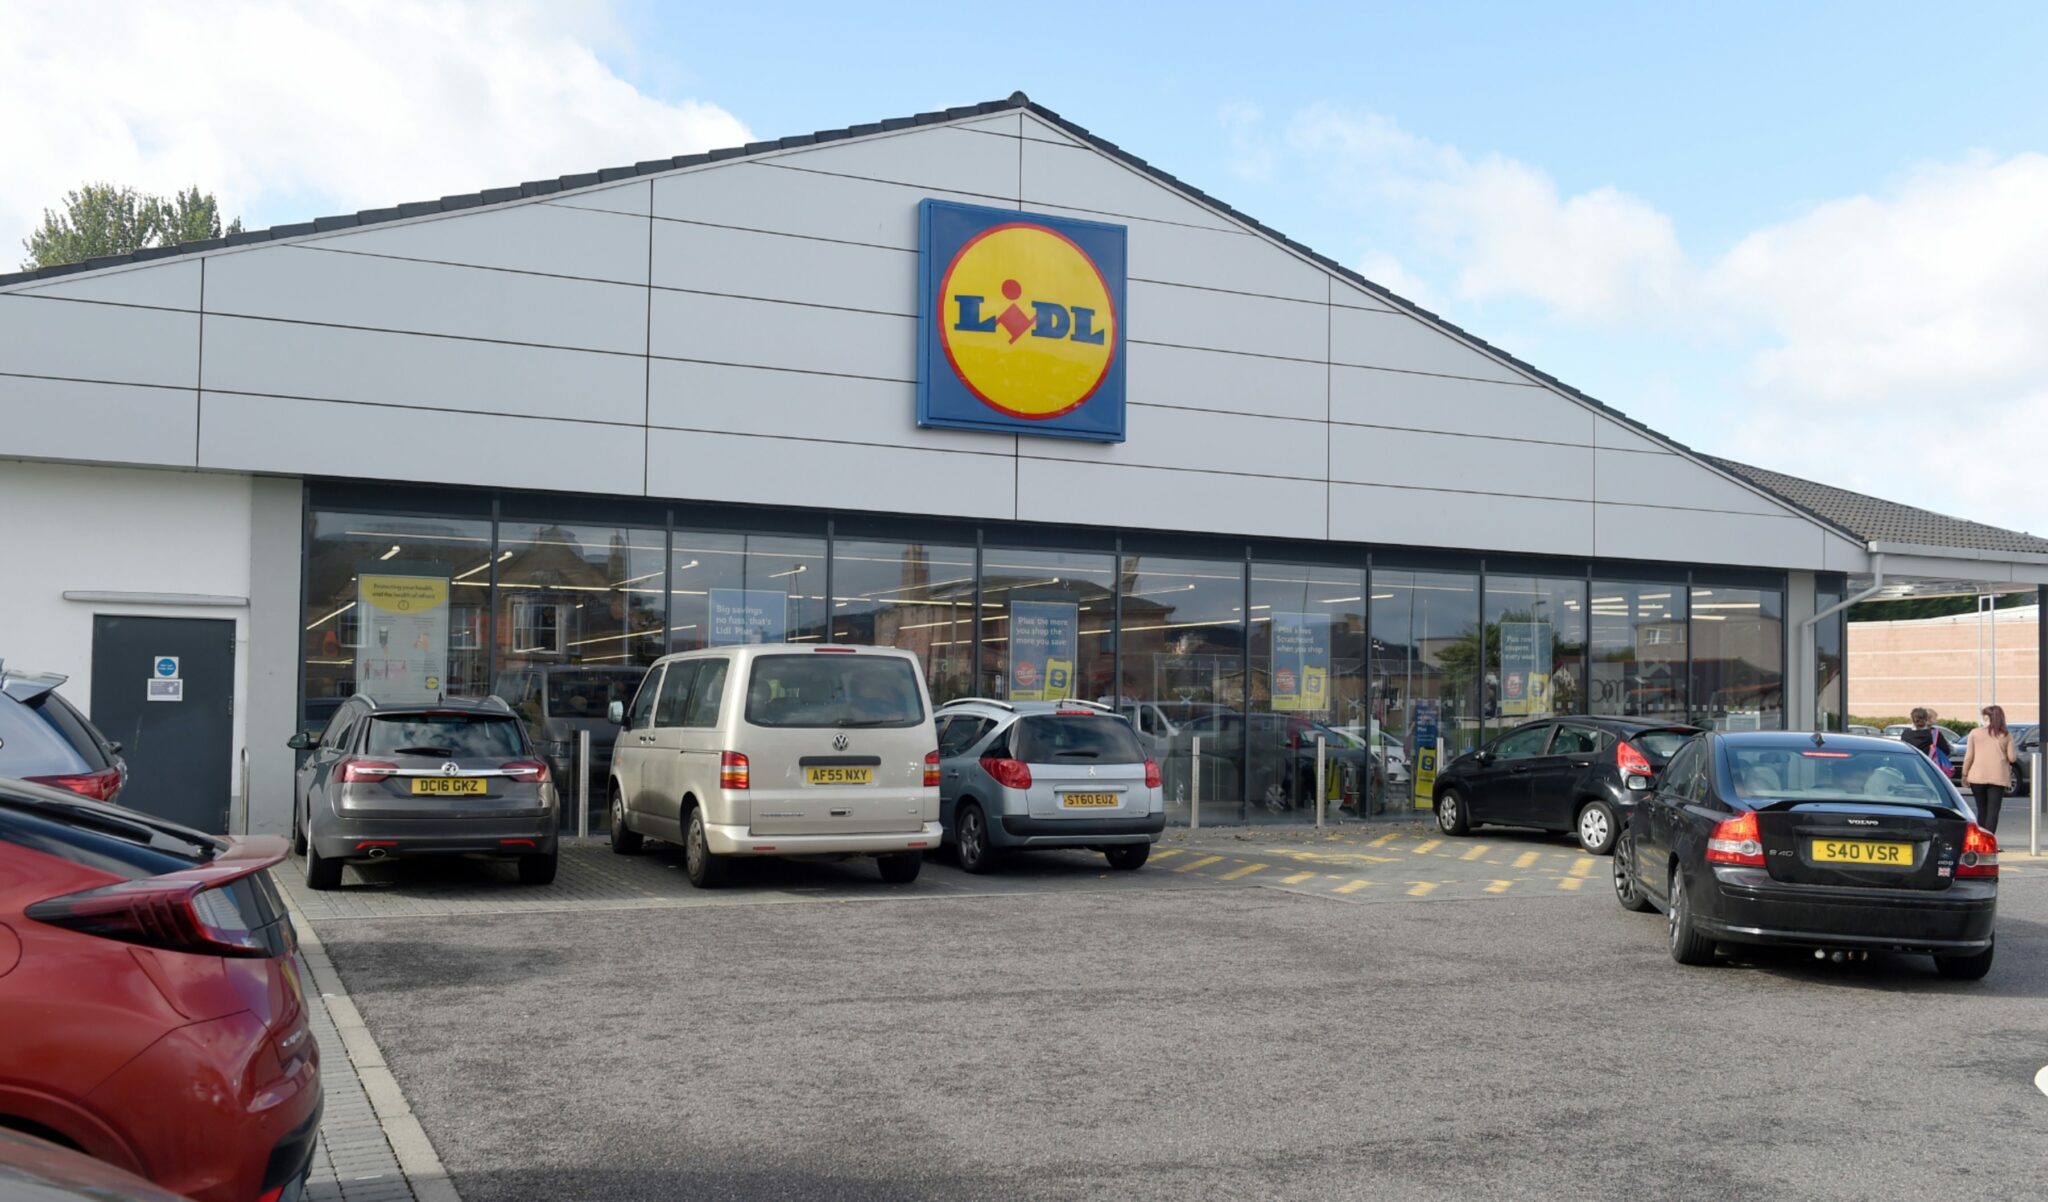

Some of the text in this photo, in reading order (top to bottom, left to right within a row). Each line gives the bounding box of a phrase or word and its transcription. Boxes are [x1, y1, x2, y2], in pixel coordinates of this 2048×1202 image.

[716, 604, 763, 616] Big savings
[749, 617, 772, 625] that's
[1018, 616, 1034, 625] Plus
[716, 626, 731, 634] Lidl
[1016, 628, 1030, 636] you
[1032, 628, 1049, 636] shop
[1035, 639, 1050, 647] you
[812, 768, 868, 781] AF55 NXY
[420, 780, 478, 792] DC16 GKZ
[1067, 794, 1115, 805] ST60 EUZ
[1826, 843, 1899, 861] S40 VSR
